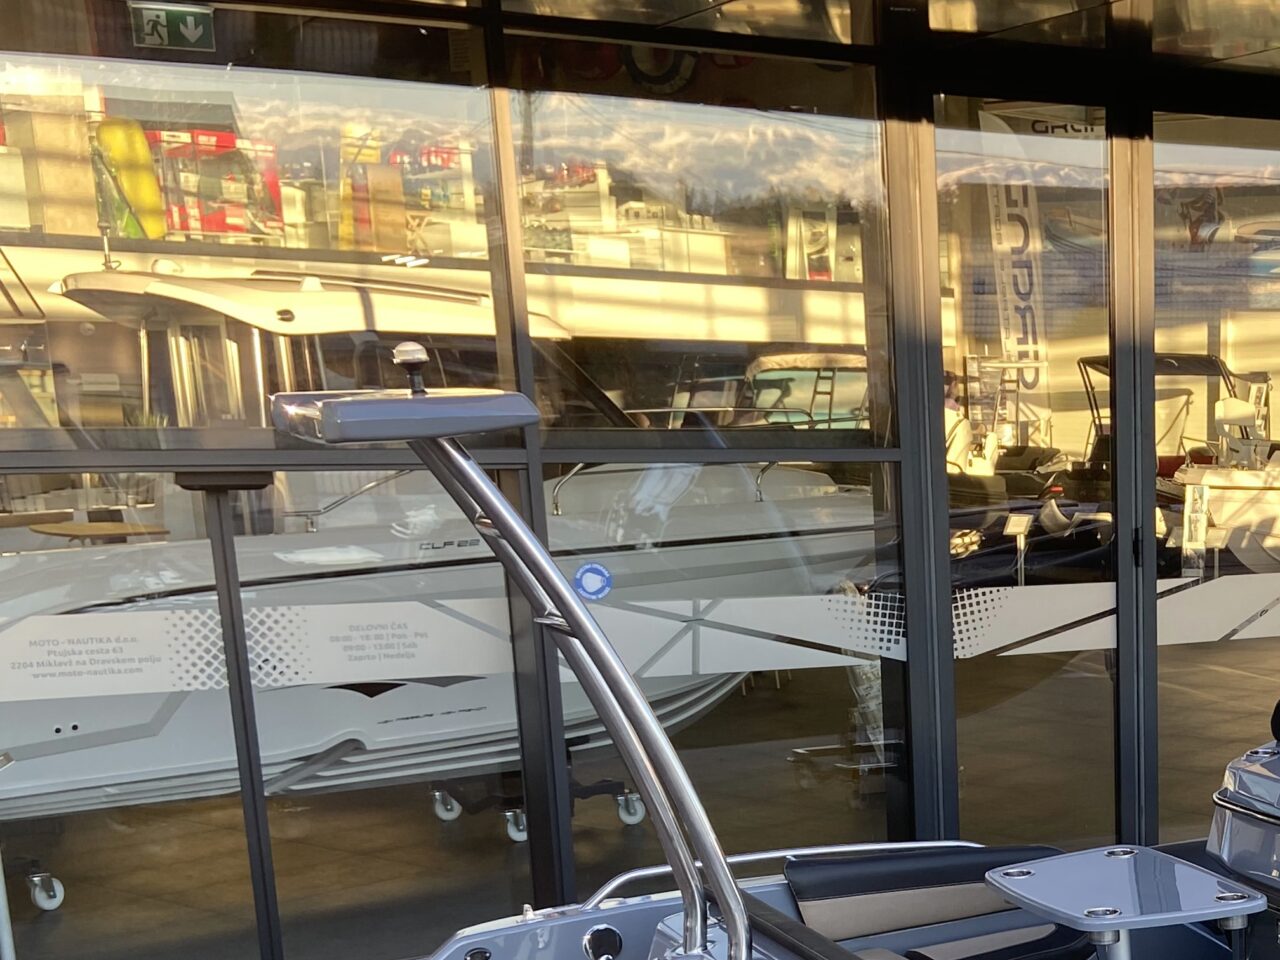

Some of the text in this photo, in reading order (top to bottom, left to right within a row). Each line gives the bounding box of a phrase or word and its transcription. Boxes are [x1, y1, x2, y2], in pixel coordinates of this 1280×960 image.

[29, 639, 59, 648] MOTO
[67, 637, 113, 646] NAUTIKA
[47, 646, 124, 658] Ptujska cesta 63
[75, 659, 87, 667] na
[89, 656, 136, 666] Dravskem
[32, 666, 144, 679] www.moto-nautika.com
